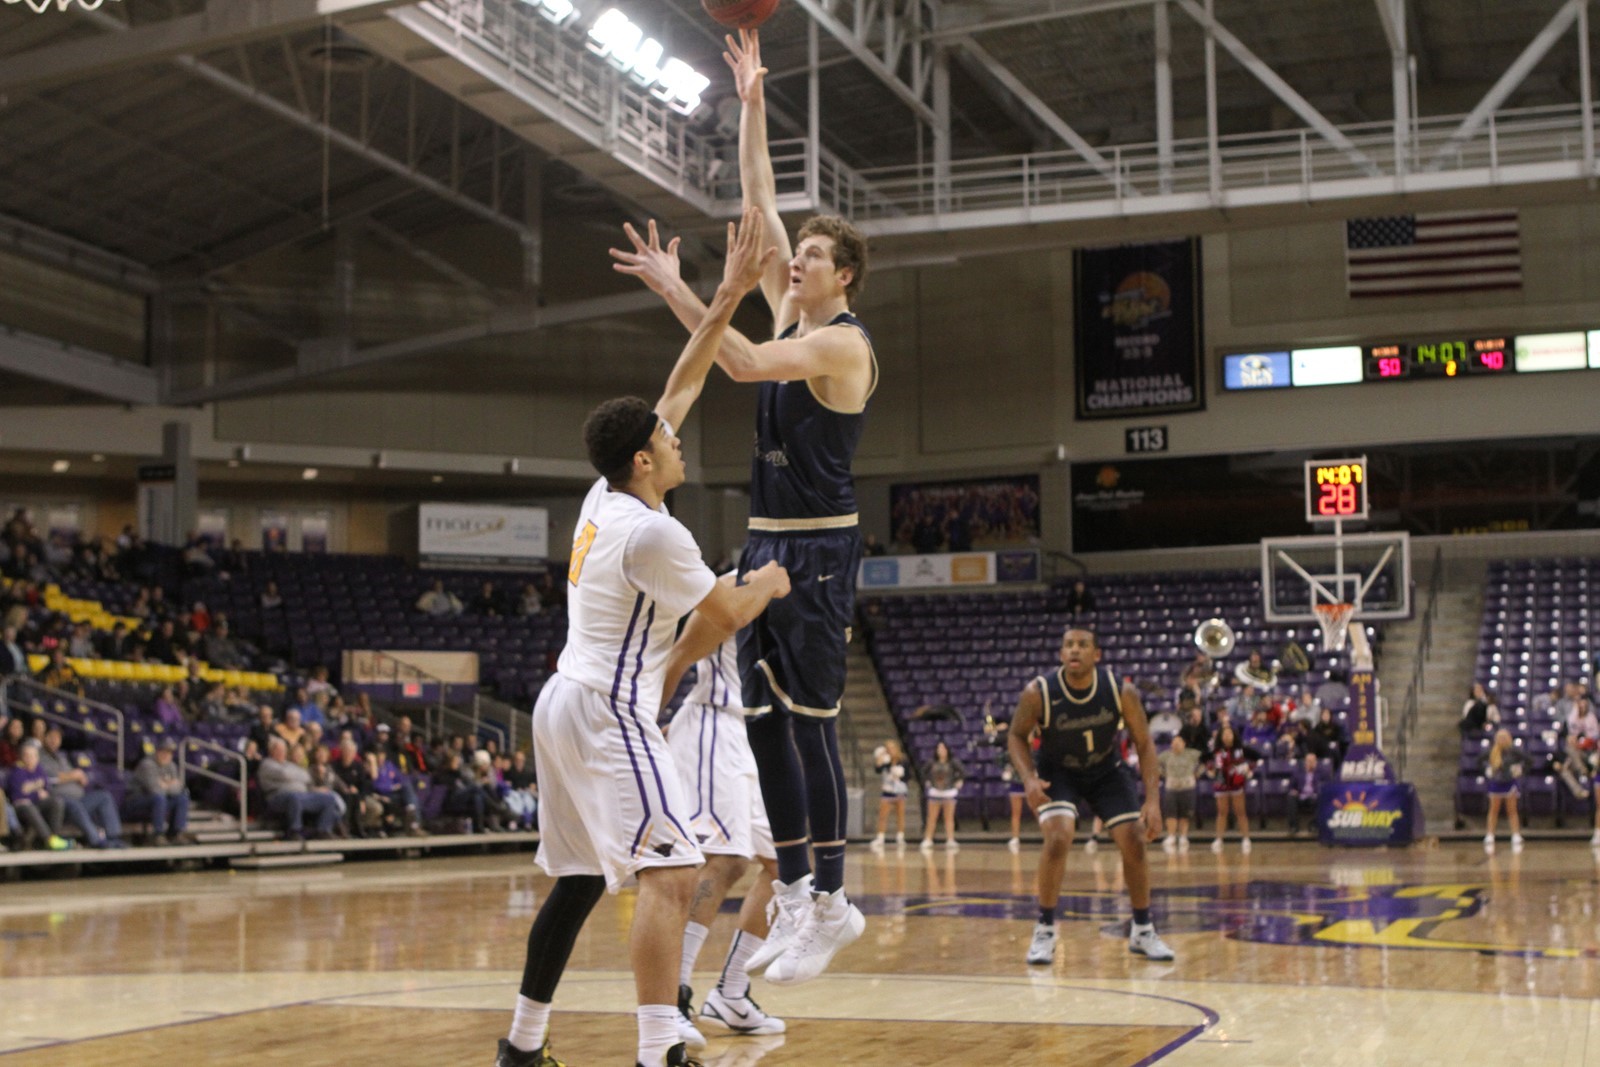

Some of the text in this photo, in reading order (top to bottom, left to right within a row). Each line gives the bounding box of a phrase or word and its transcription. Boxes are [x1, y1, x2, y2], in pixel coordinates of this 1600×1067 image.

[1379, 358, 1401, 377] 50
[1446, 360, 1457, 377] 2
[1480, 351, 1503, 370] 40
[1095, 373, 1184, 392] NATIONAL
[1086, 386, 1194, 409] CHAMPIONS
[1129, 428, 1164, 450] 113
[1316, 464, 1363, 485] 14:07
[1318, 484, 1356, 515] 28
[1082, 729, 1095, 753] 1
[1327, 809, 1402, 829] SUBWAY
